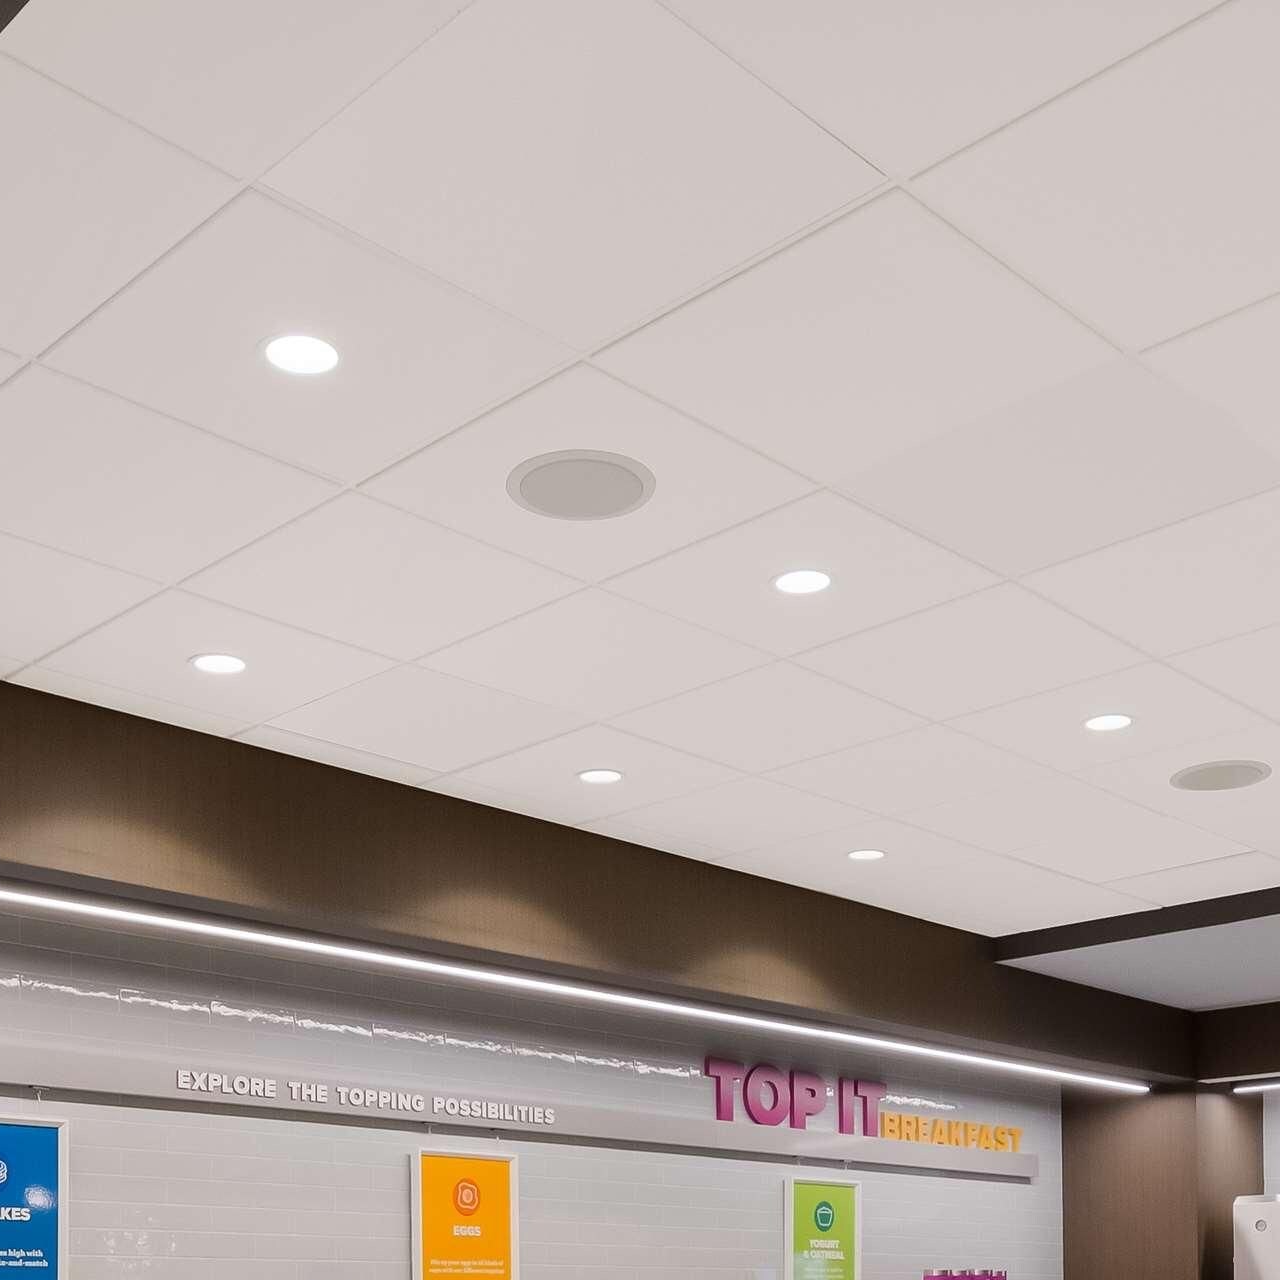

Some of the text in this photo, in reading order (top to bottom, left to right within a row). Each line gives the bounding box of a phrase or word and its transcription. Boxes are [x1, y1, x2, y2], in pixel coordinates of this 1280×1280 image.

[176, 1069, 555, 1126] EXPLORE THE TOPPING POSSIBILITIES
[704, 1055, 887, 1138] TOP IT
[880, 1111, 1024, 1153] BREAKFAST
[453, 1225, 481, 1237] EGGS
[8, 1248, 26, 1259] high
[26, 1249, 43, 1257] with
